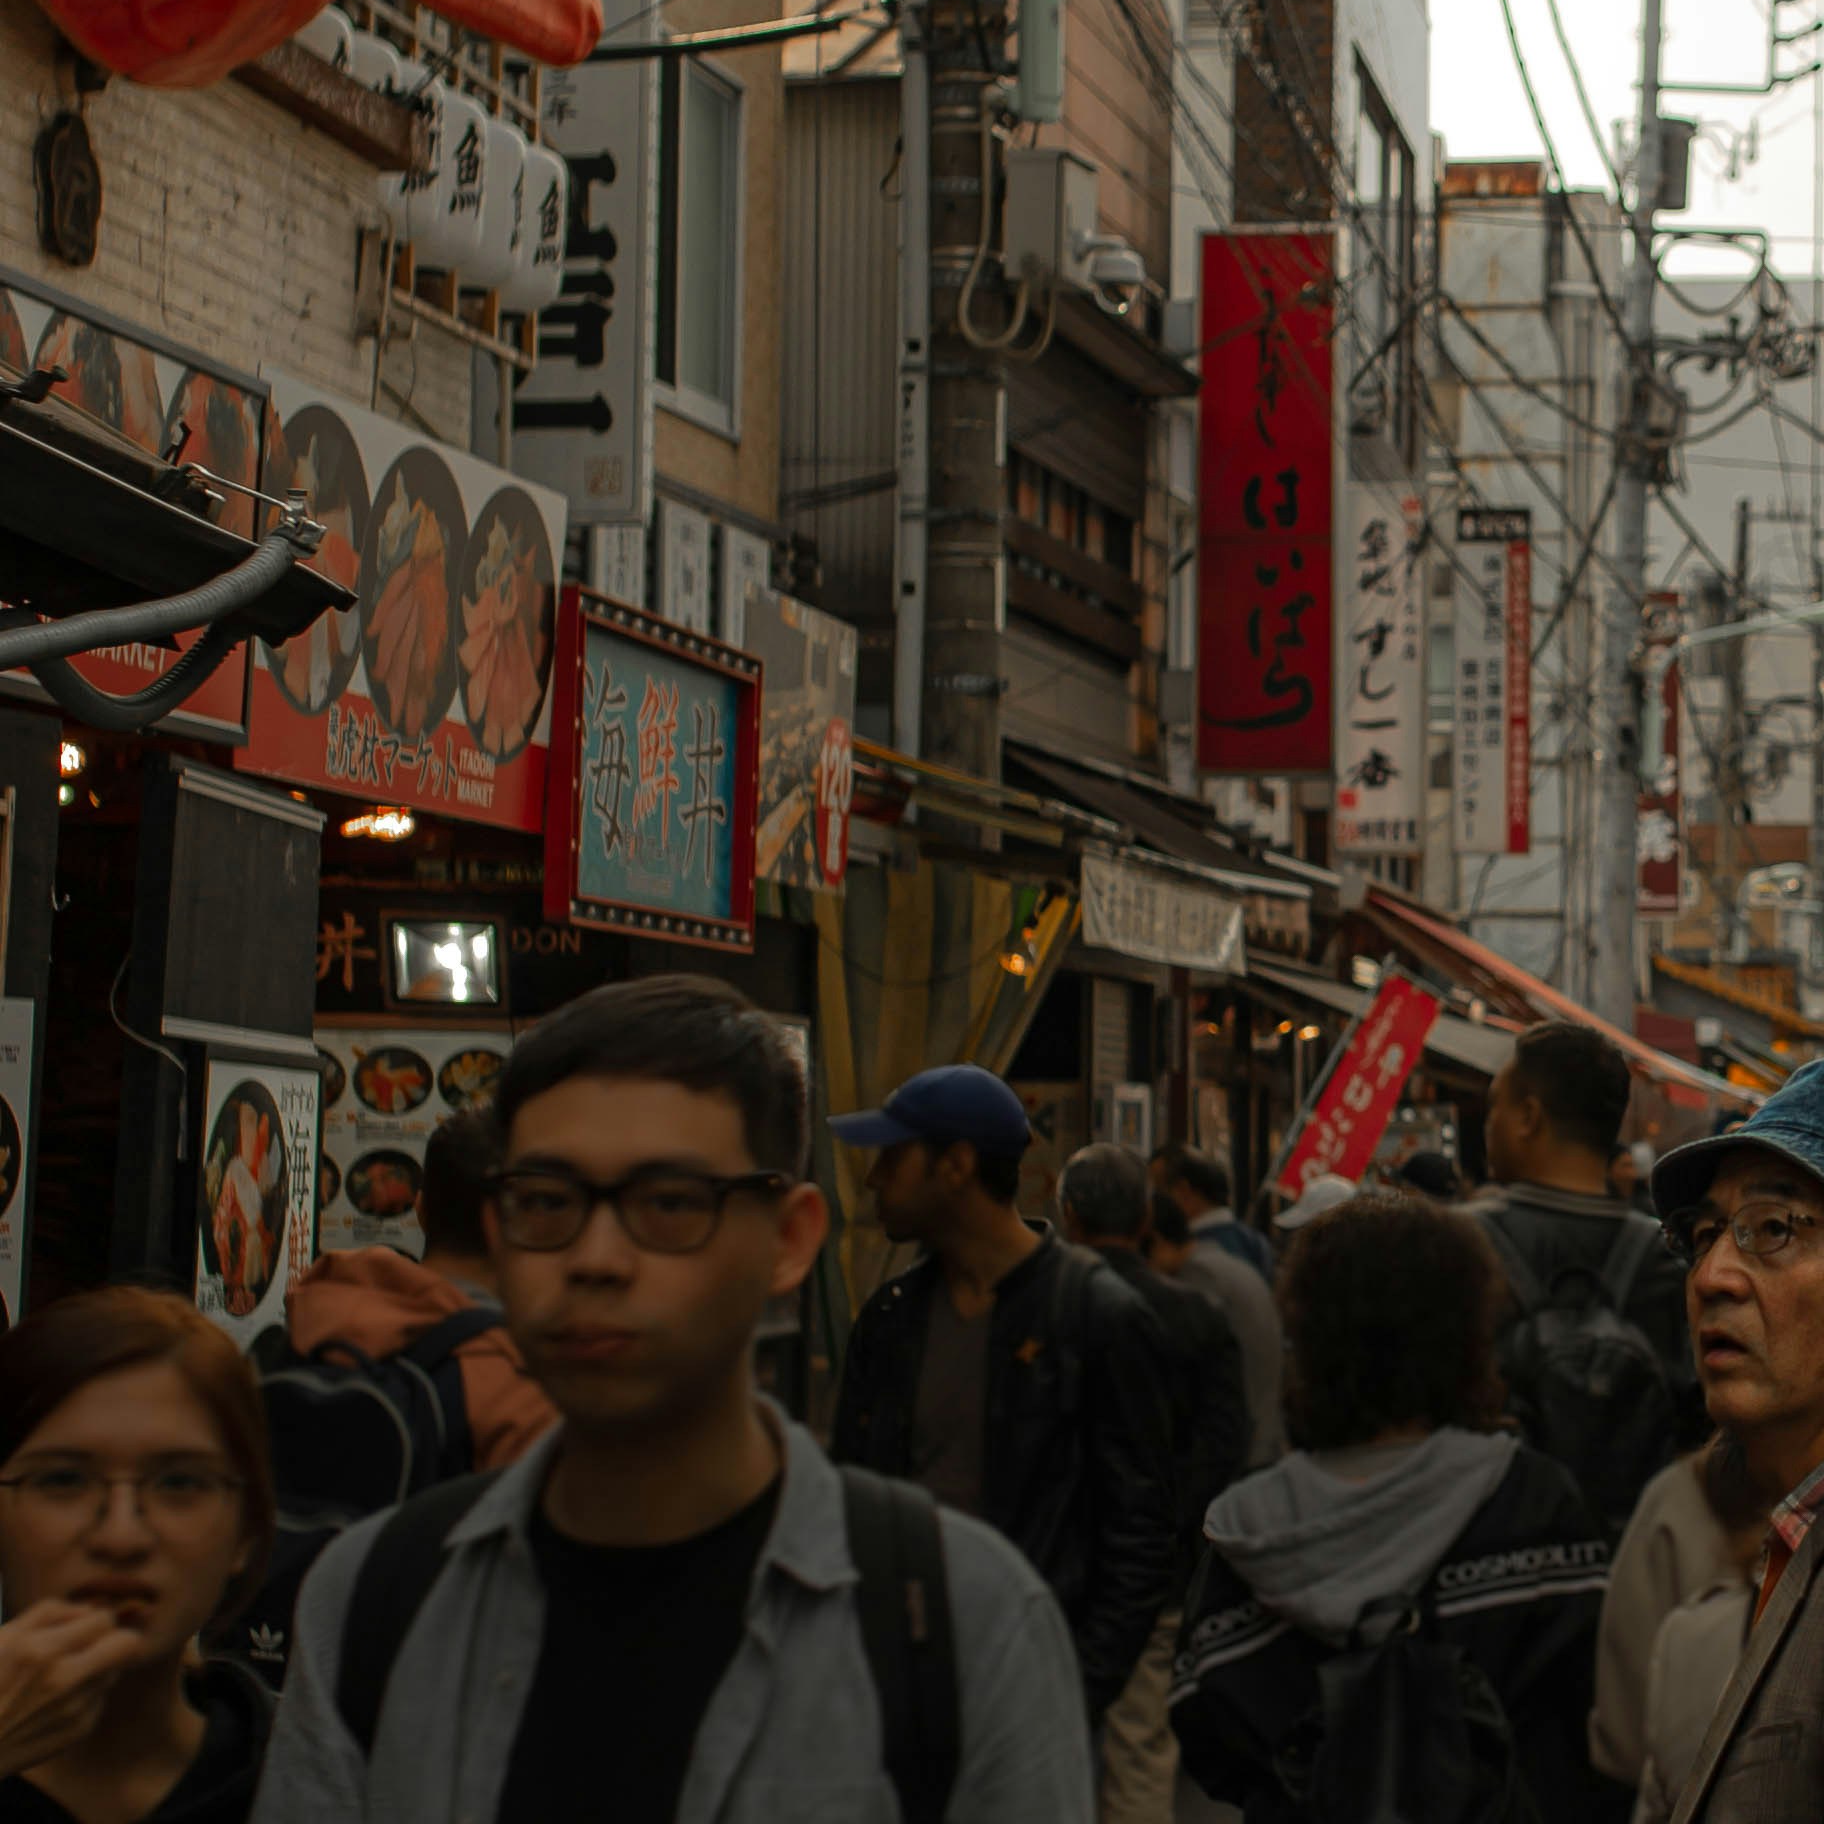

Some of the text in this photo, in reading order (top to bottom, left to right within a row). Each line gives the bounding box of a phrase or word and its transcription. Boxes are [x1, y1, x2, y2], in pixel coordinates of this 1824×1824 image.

[583, 658, 727, 890] 海鮮丼
[511, 927, 584, 956] DON
